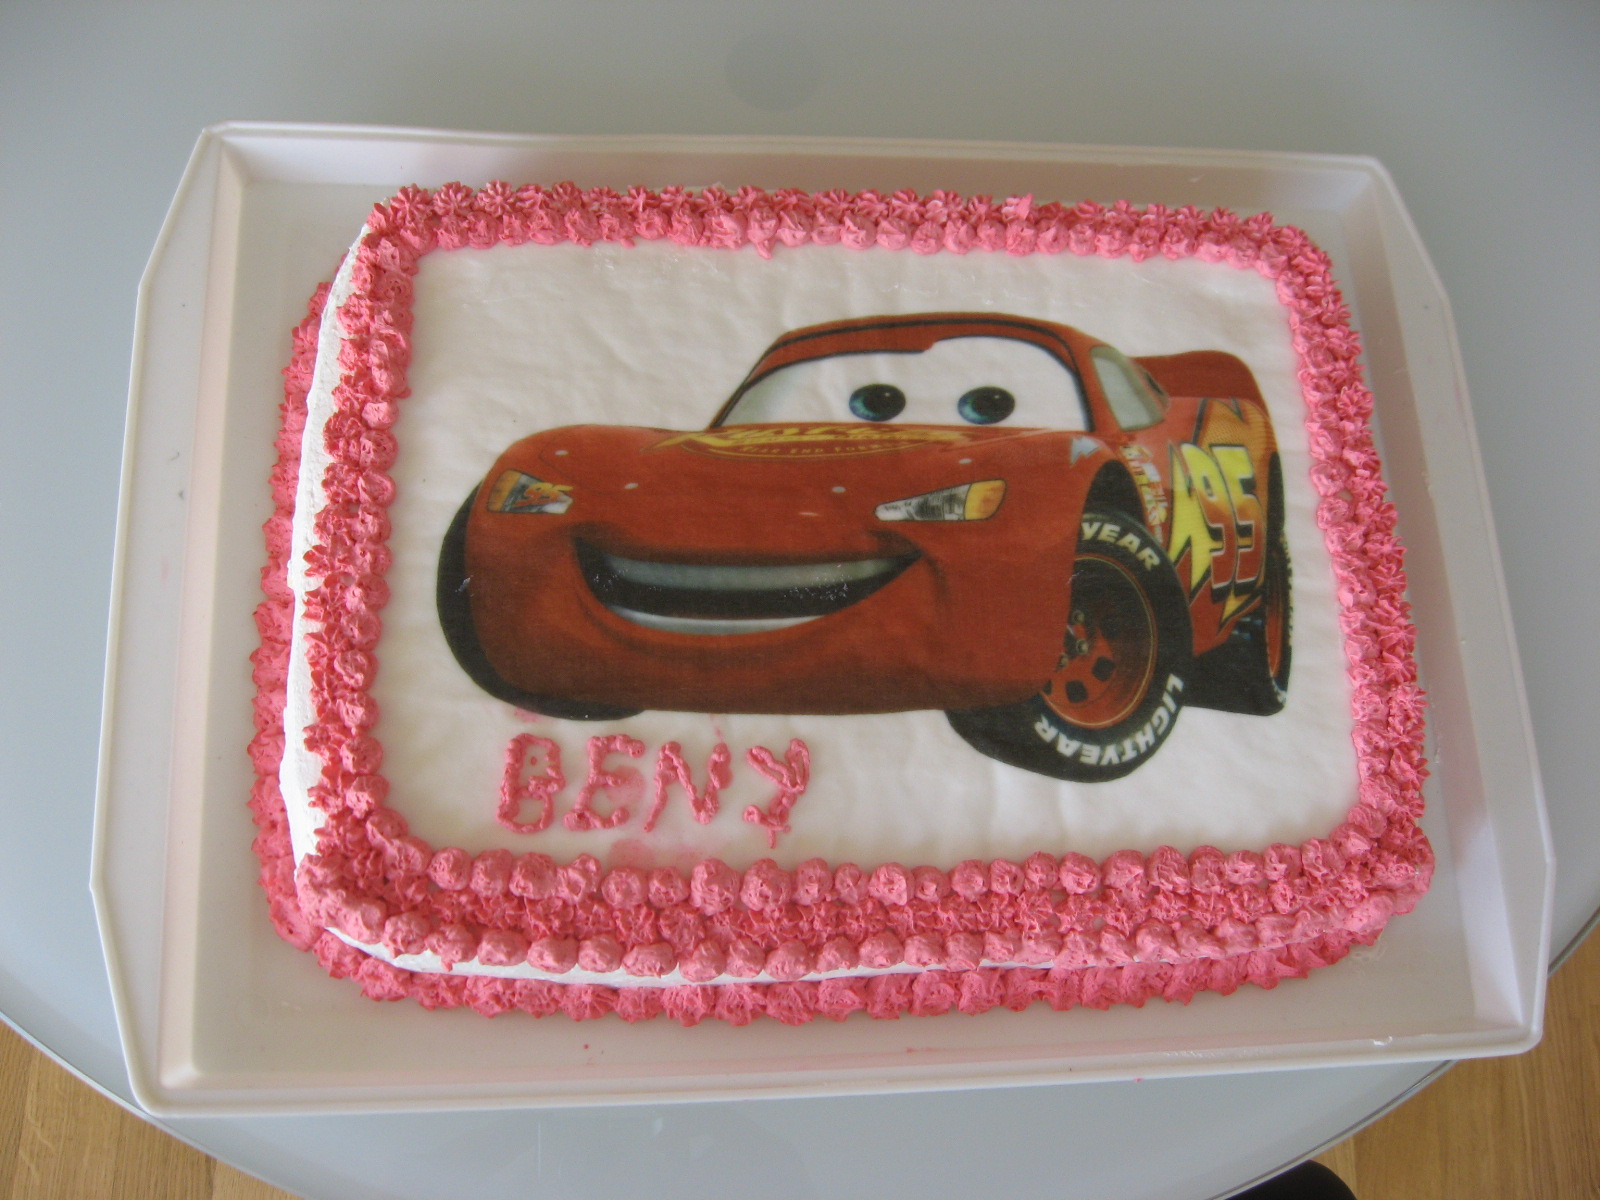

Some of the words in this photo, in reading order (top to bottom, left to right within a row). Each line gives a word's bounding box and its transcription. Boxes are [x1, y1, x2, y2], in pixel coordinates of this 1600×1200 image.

[1179, 443, 1266, 592] 95
[1034, 673, 1184, 766] LIGHTYEAR
[497, 733, 810, 848] BENY
